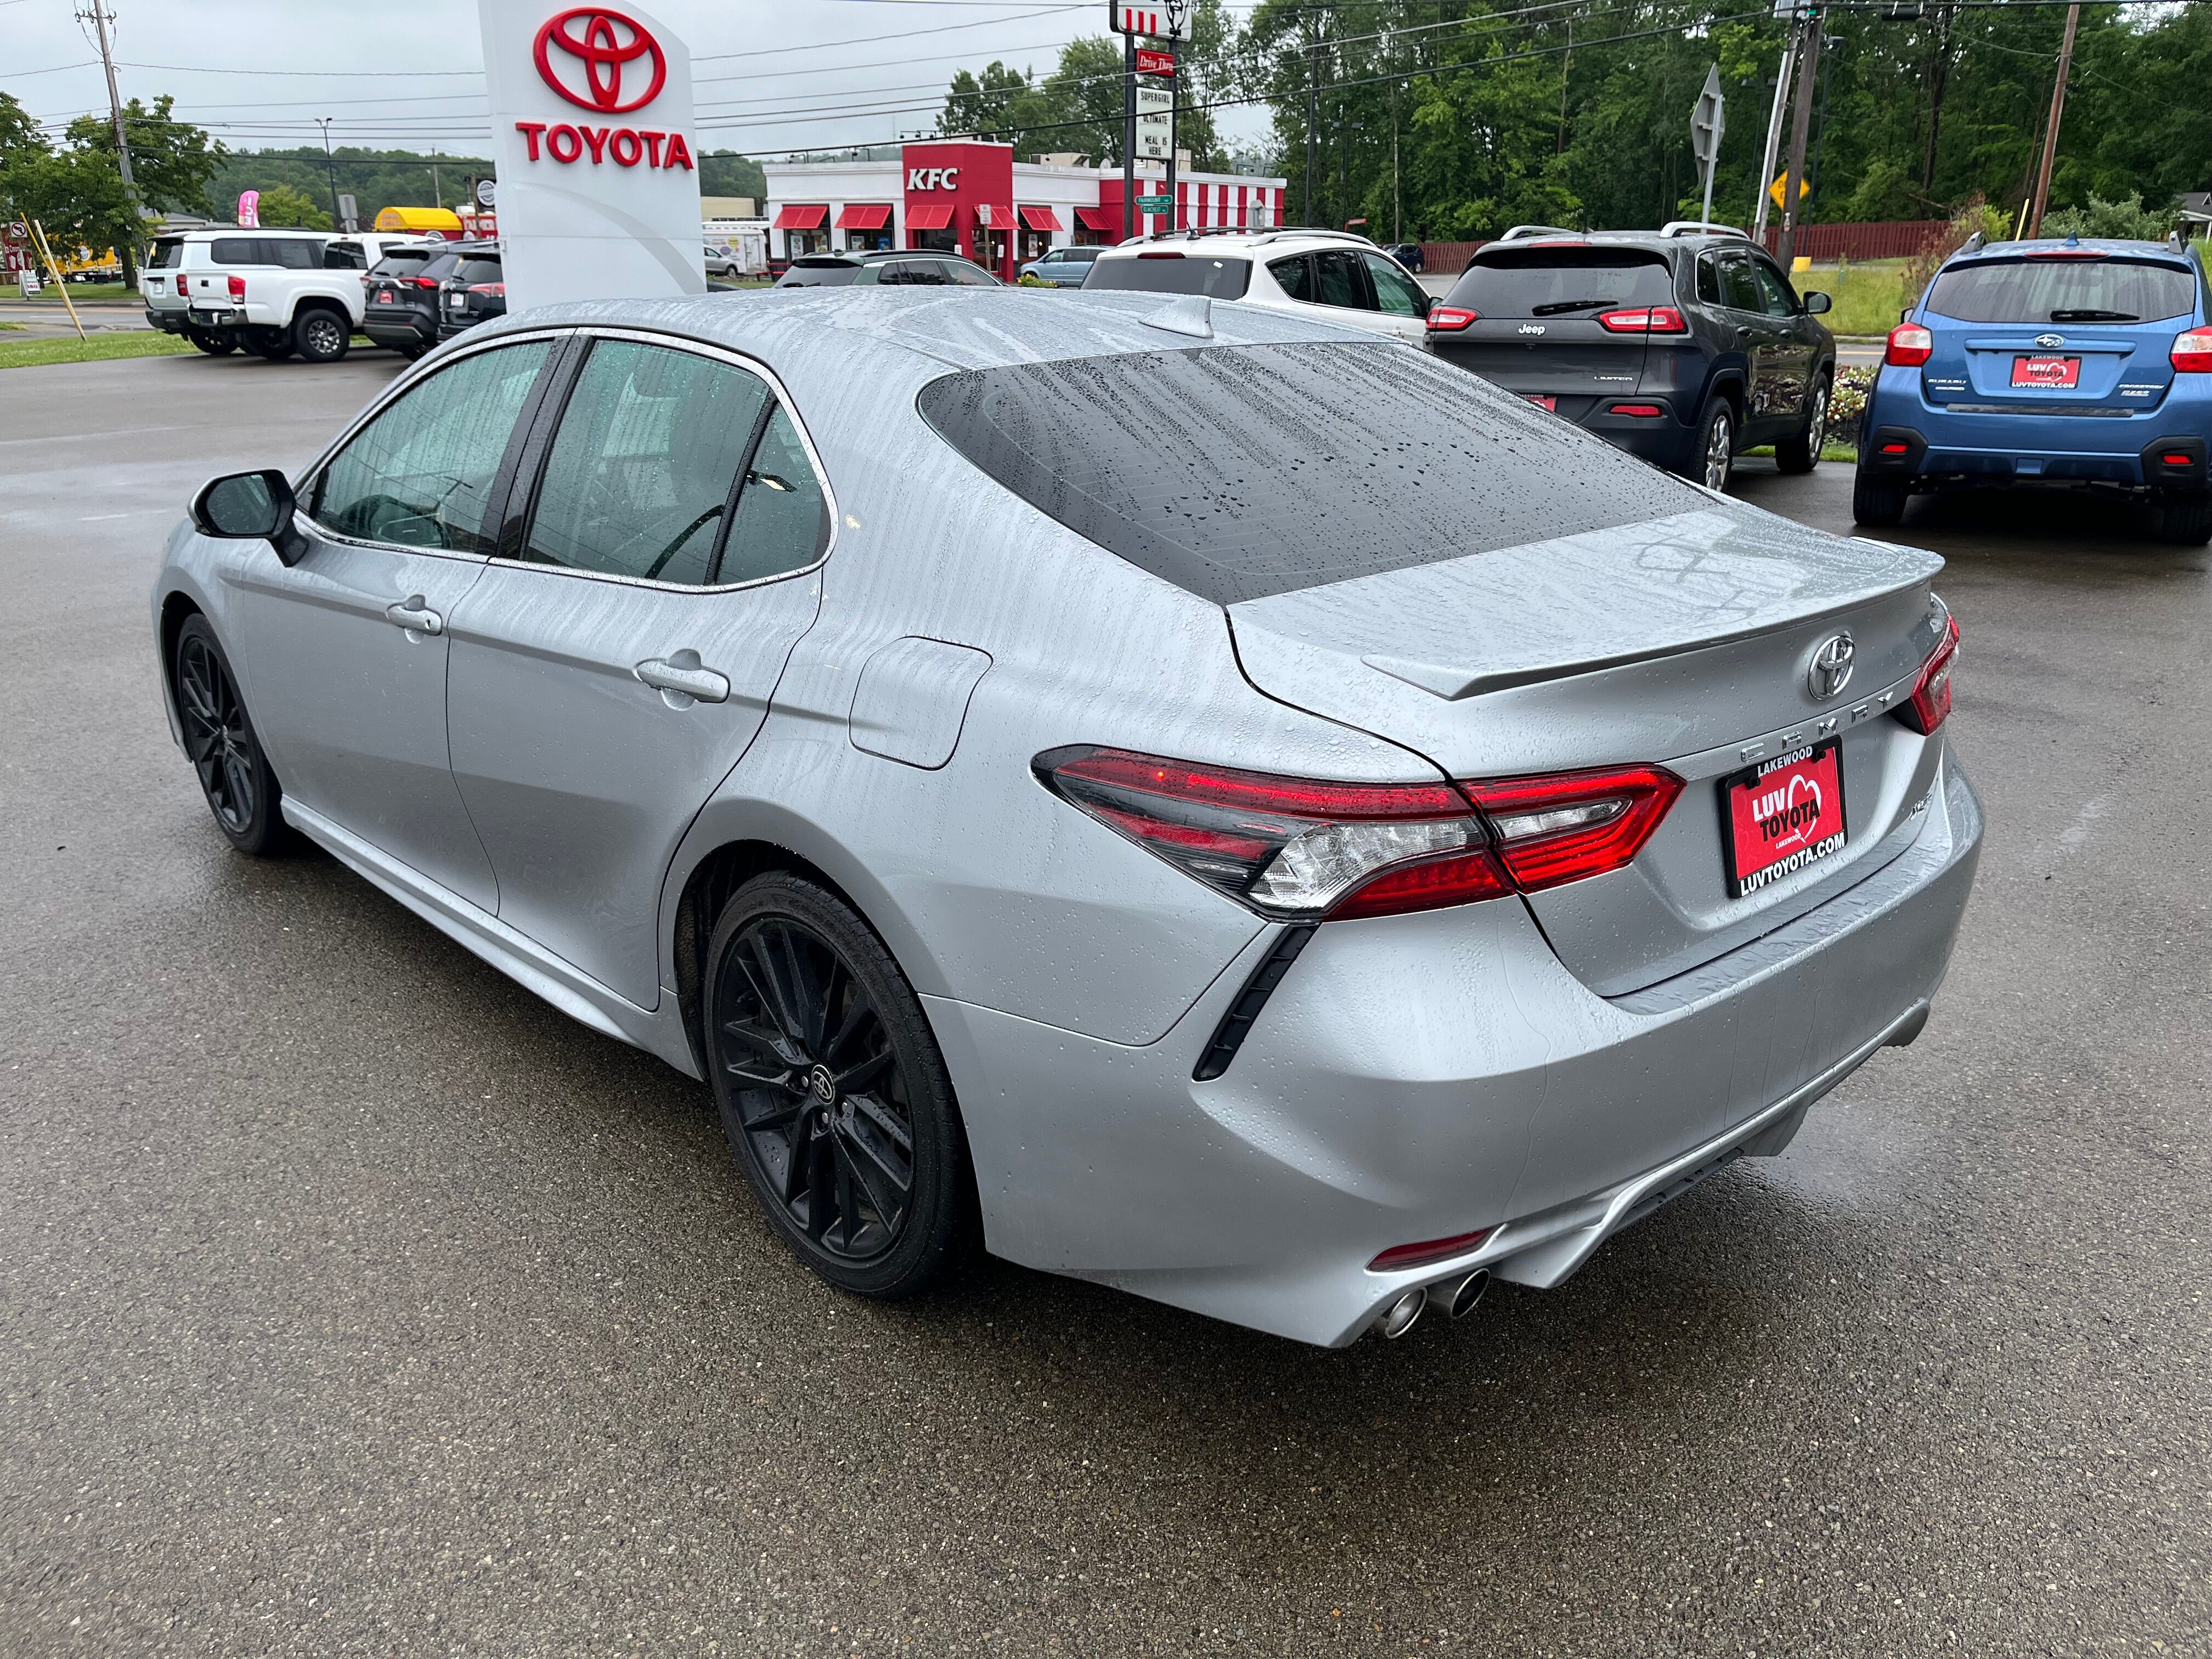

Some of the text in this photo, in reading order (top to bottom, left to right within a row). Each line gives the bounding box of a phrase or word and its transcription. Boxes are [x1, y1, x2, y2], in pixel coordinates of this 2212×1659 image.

[1139, 55, 1157, 69] Drive
[1141, 91, 1170, 104] SUPERGIRL
[1143, 114, 1167, 125] ULTIMATE
[515, 122, 694, 170] TOYOTA
[1145, 136, 1167, 145] MEAL IS
[1149, 146, 1161, 155] HERE
[906, 167, 958, 190] KFC
[1518, 324, 1545, 335] Jeep
[2027, 363, 2047, 371] LUV
[1741, 691, 1894, 764] CAMRY
[1757, 746, 1813, 777] LAKEWOOD
[1752, 787, 1786, 822] LUV
[1759, 798, 1821, 842] TOYOTA
[1775, 832, 1802, 849] LAKEWOOD
[1740, 832, 1846, 897] LUVTOYOTA.COM
